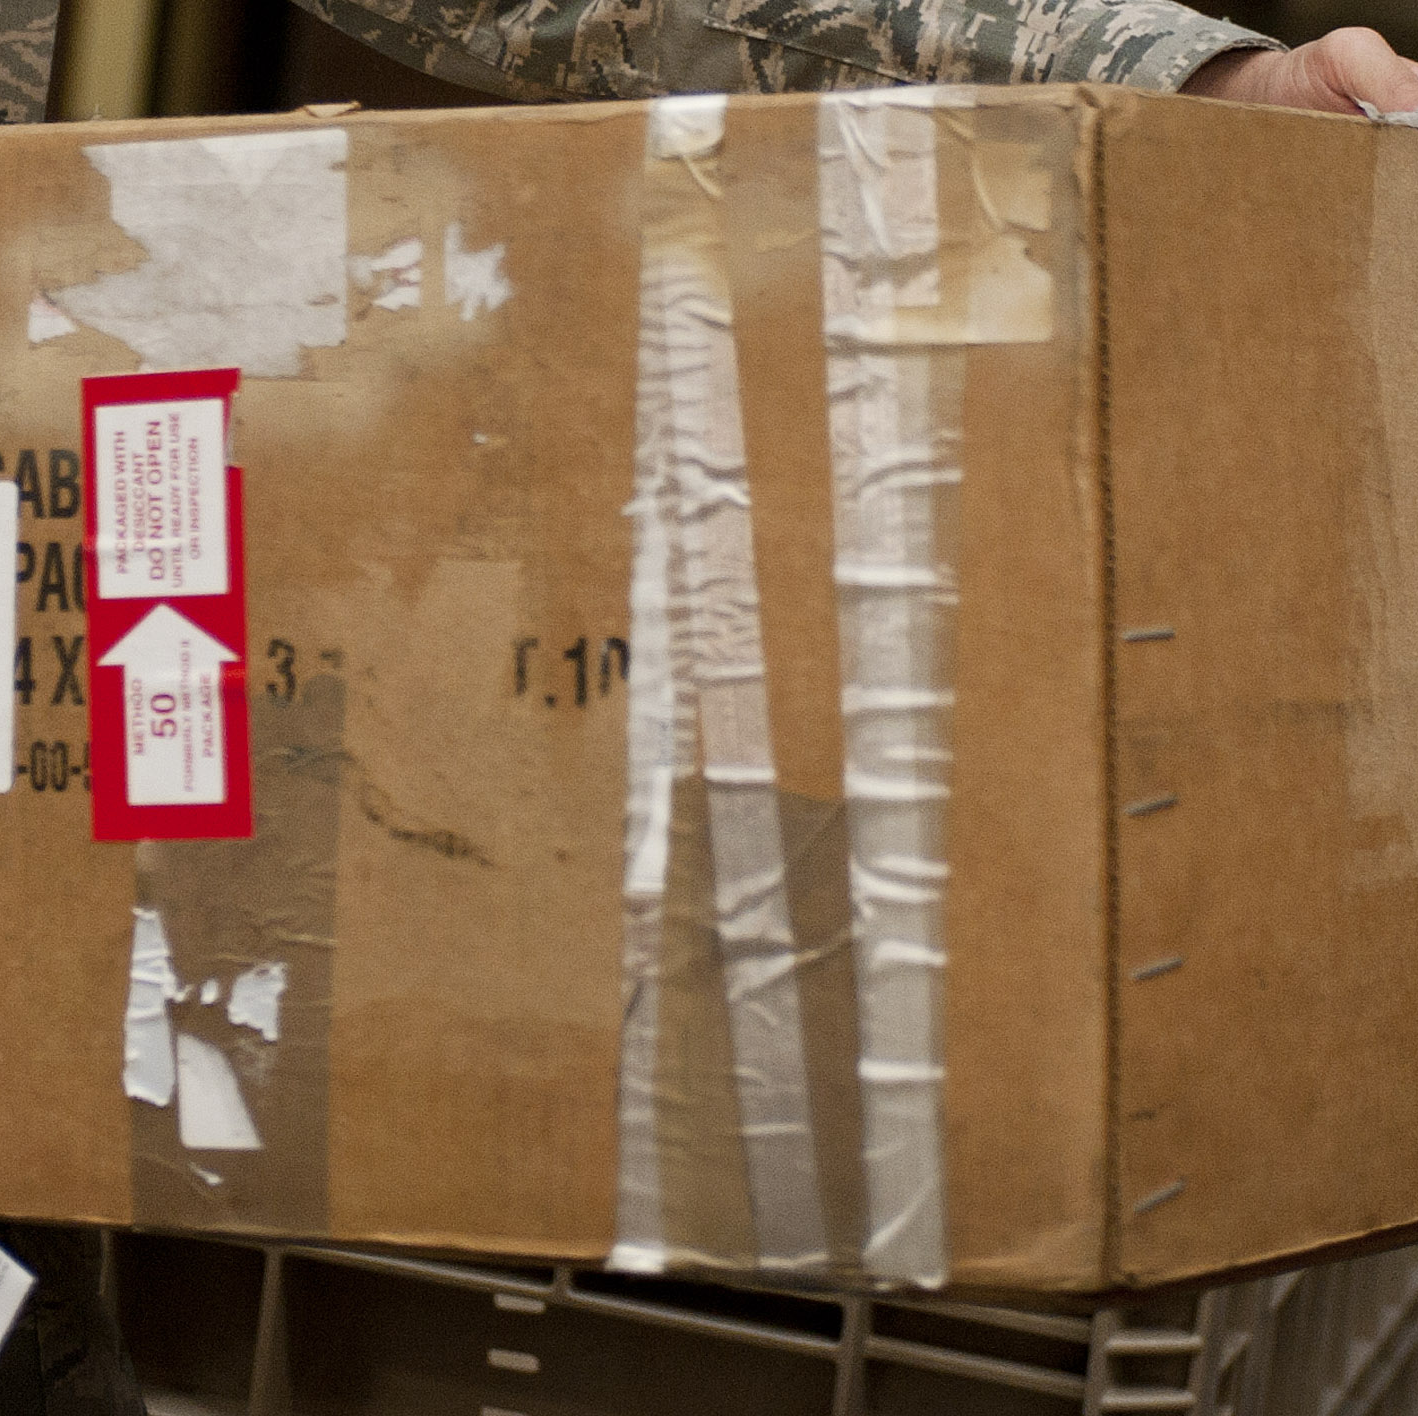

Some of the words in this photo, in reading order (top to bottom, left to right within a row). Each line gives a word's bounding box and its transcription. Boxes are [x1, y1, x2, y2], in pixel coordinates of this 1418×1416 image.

[113, 430, 127, 473] WITH
[168, 412, 181, 444] USE
[146, 420, 163, 486] OPEN
[168, 447, 181, 481] FOR
[132, 451, 145, 552] DESICCANT
[187, 436, 200, 533] INSPECTION
[114, 478, 130, 575] PACKAGED
[147, 494, 164, 540] NOT
[169, 485, 182, 537] READY
[149, 546, 165, 581] DO
[130, 678, 144, 757] METHOD
[150, 692, 179, 739] 50
